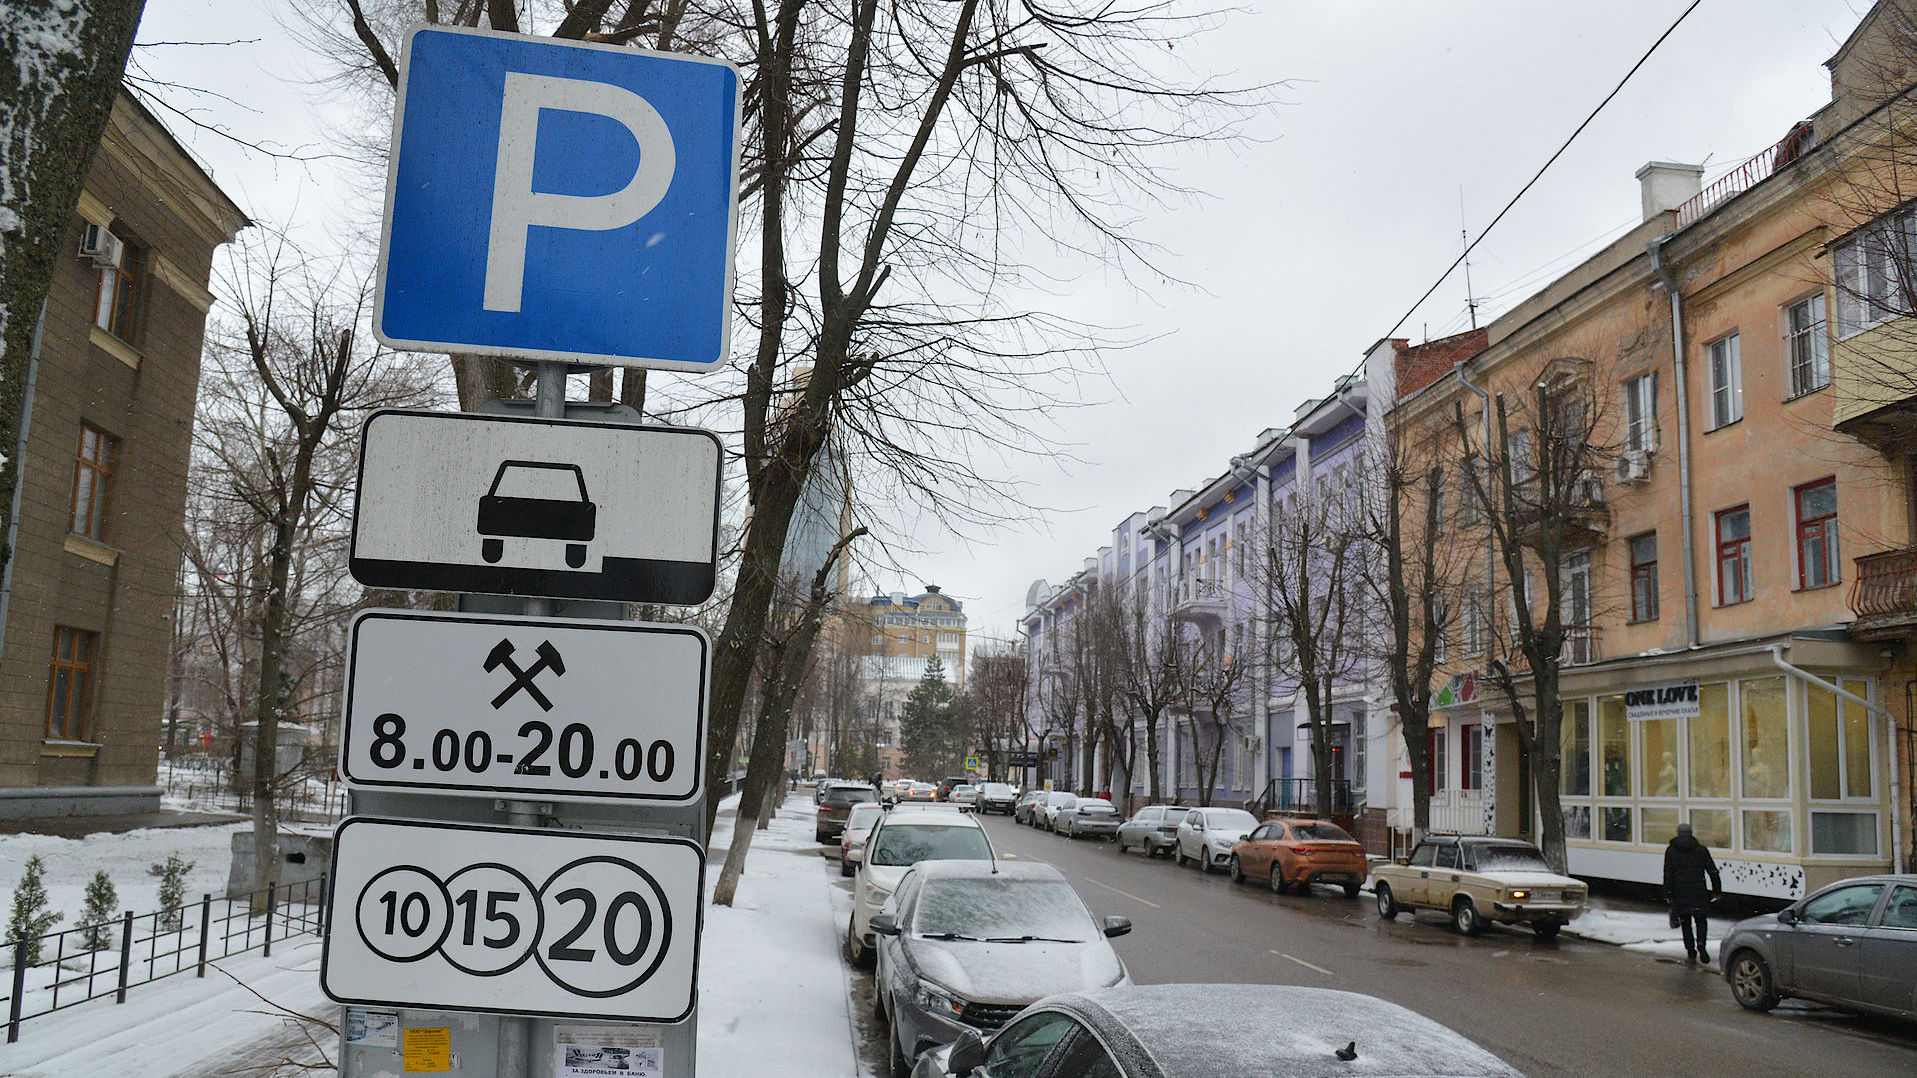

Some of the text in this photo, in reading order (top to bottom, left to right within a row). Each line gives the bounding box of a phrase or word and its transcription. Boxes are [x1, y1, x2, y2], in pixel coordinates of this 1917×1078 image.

[483, 71, 676, 313] P
[1626, 685, 1698, 706] ONE LOVE
[369, 713, 676, 783] 8.00-20.00
[379, 888, 652, 966] 10 15 20
